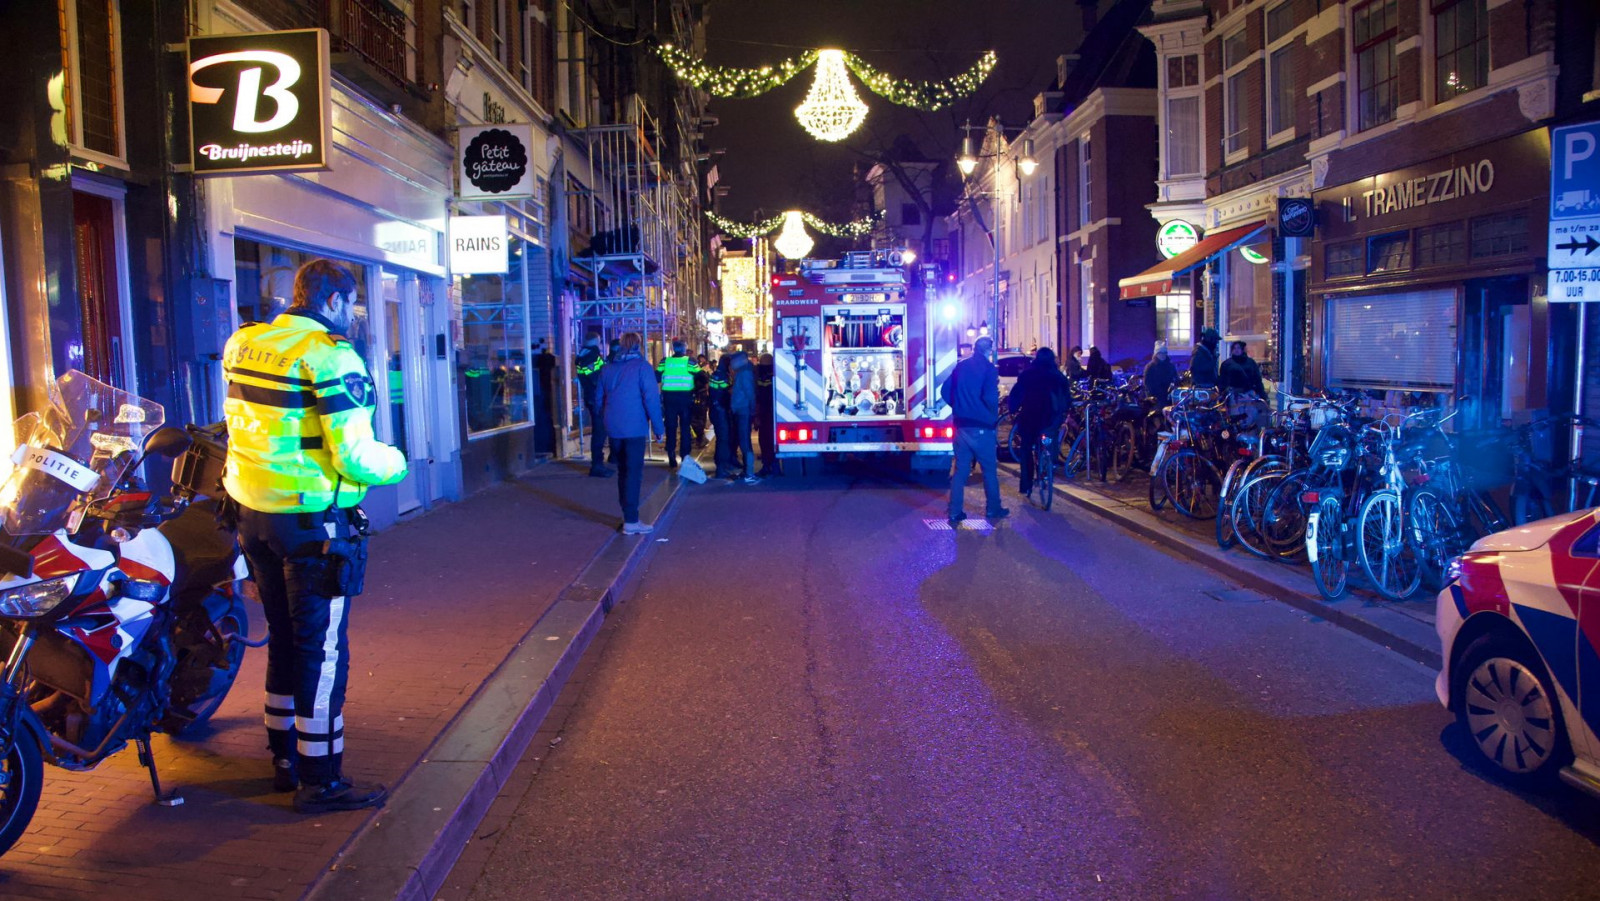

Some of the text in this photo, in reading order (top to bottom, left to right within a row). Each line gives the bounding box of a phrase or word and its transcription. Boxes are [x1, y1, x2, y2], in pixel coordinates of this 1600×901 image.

[199, 140, 312, 162] Bruijnesteijn
[481, 144, 510, 159] Petit
[1564, 131, 1596, 179] P
[472, 160, 520, 179] gâteau
[1343, 196, 1357, 222] IL
[1362, 159, 1495, 218] TRAMEZZINO
[1555, 224, 1599, 234] ma t/m za
[456, 236, 500, 252] RAINS
[1566, 286, 1583, 297] UUR
[776, 298, 819, 306] BRANDWEER
[29, 453, 80, 480] POLITIE
